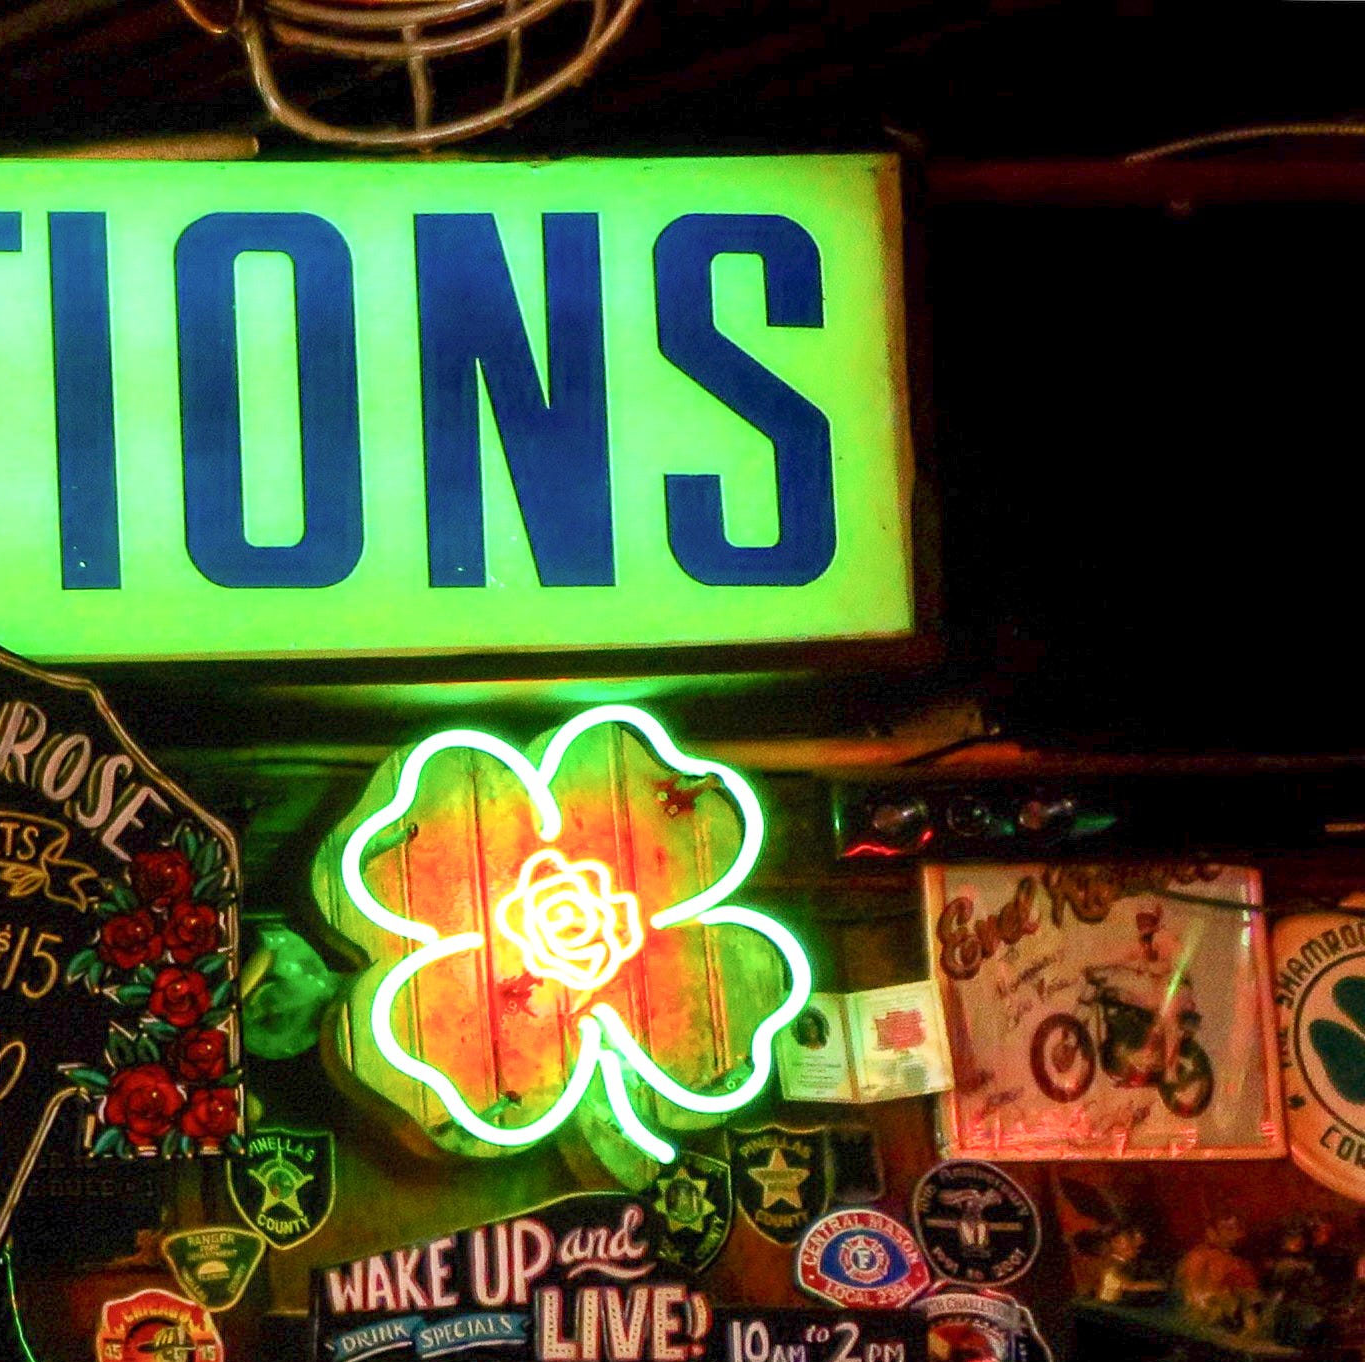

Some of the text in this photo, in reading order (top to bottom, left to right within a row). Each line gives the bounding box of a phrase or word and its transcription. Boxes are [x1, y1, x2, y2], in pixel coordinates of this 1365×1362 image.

[256, 1213, 311, 1233] COUNTY
[326, 1236, 460, 1314] WAKE
[475, 1217, 553, 1311] UP
[559, 1205, 646, 1262] and
[340, 1314, 514, 1352] DRINK SPECIALS
[805, 1325, 830, 1343] to
